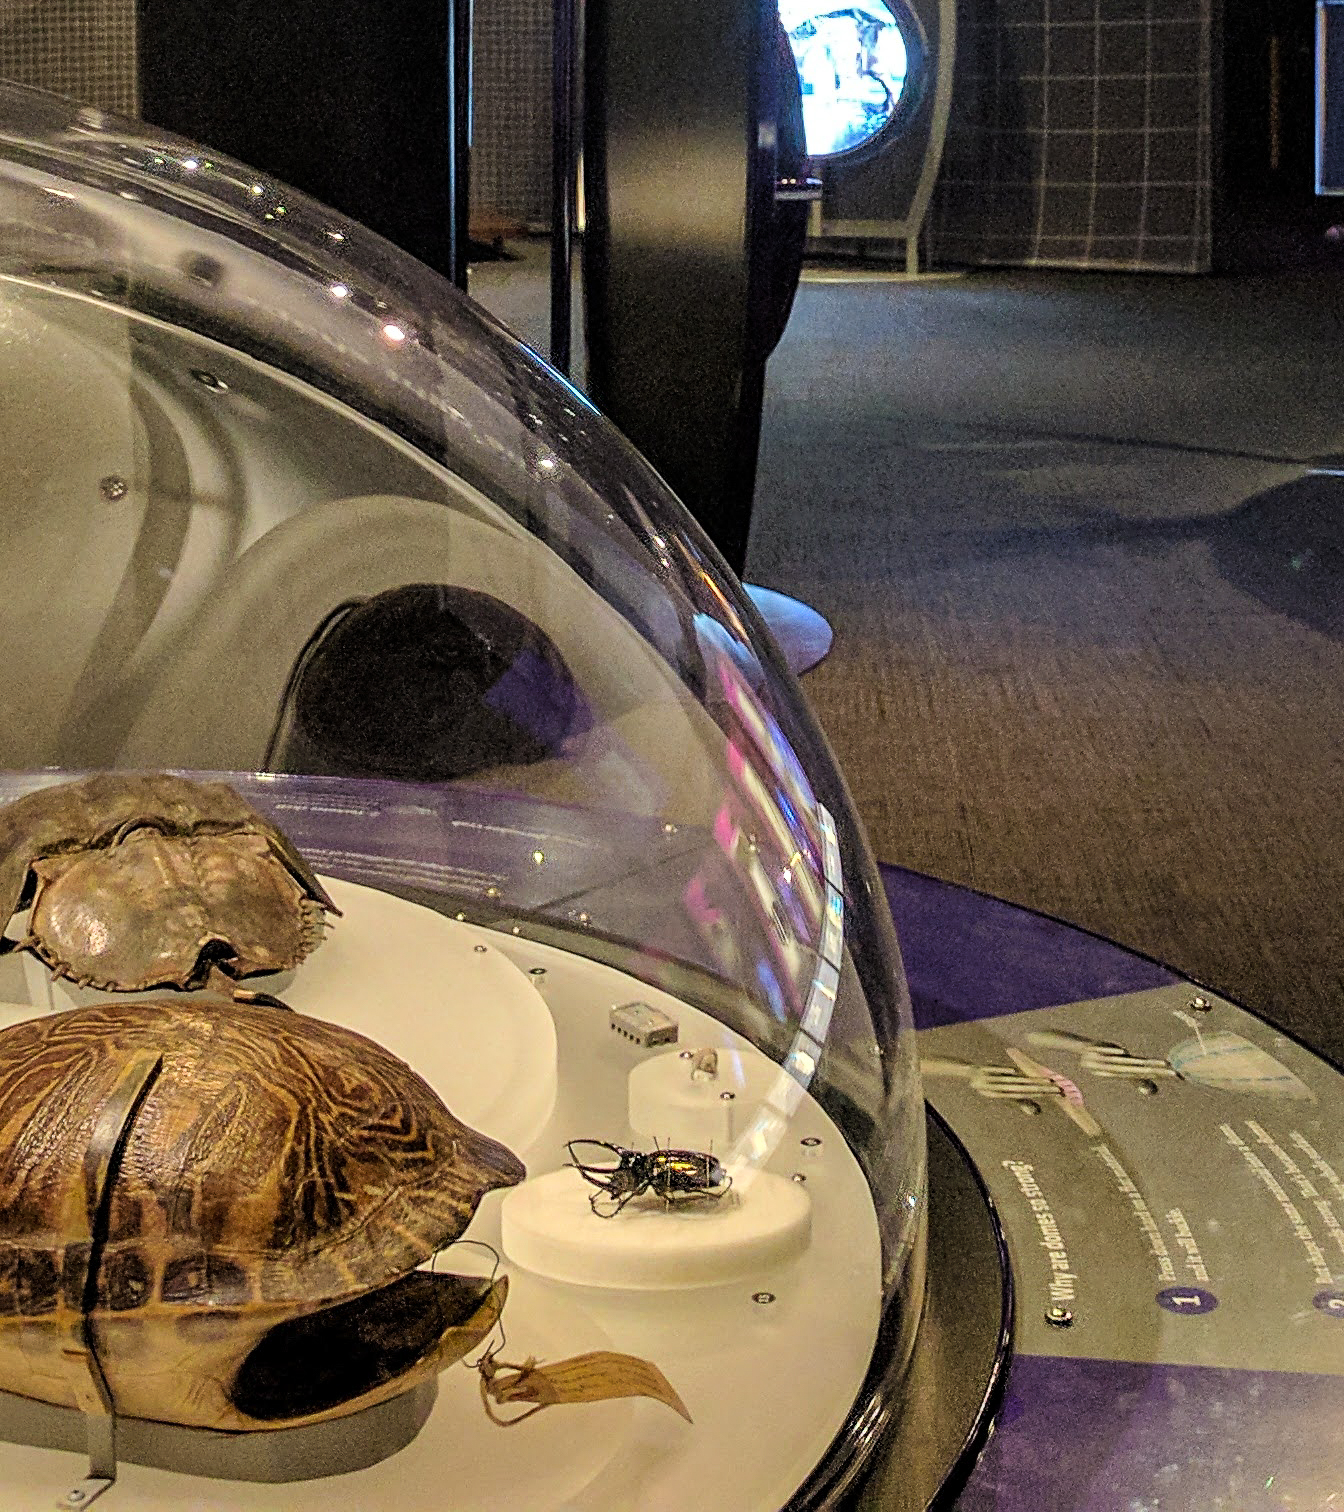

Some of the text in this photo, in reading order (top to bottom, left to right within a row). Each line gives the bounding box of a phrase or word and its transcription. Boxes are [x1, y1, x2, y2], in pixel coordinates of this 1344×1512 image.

[1002, 1161, 1077, 1300] Why are domes so strong?
[1172, 1295, 1201, 1306] 1
